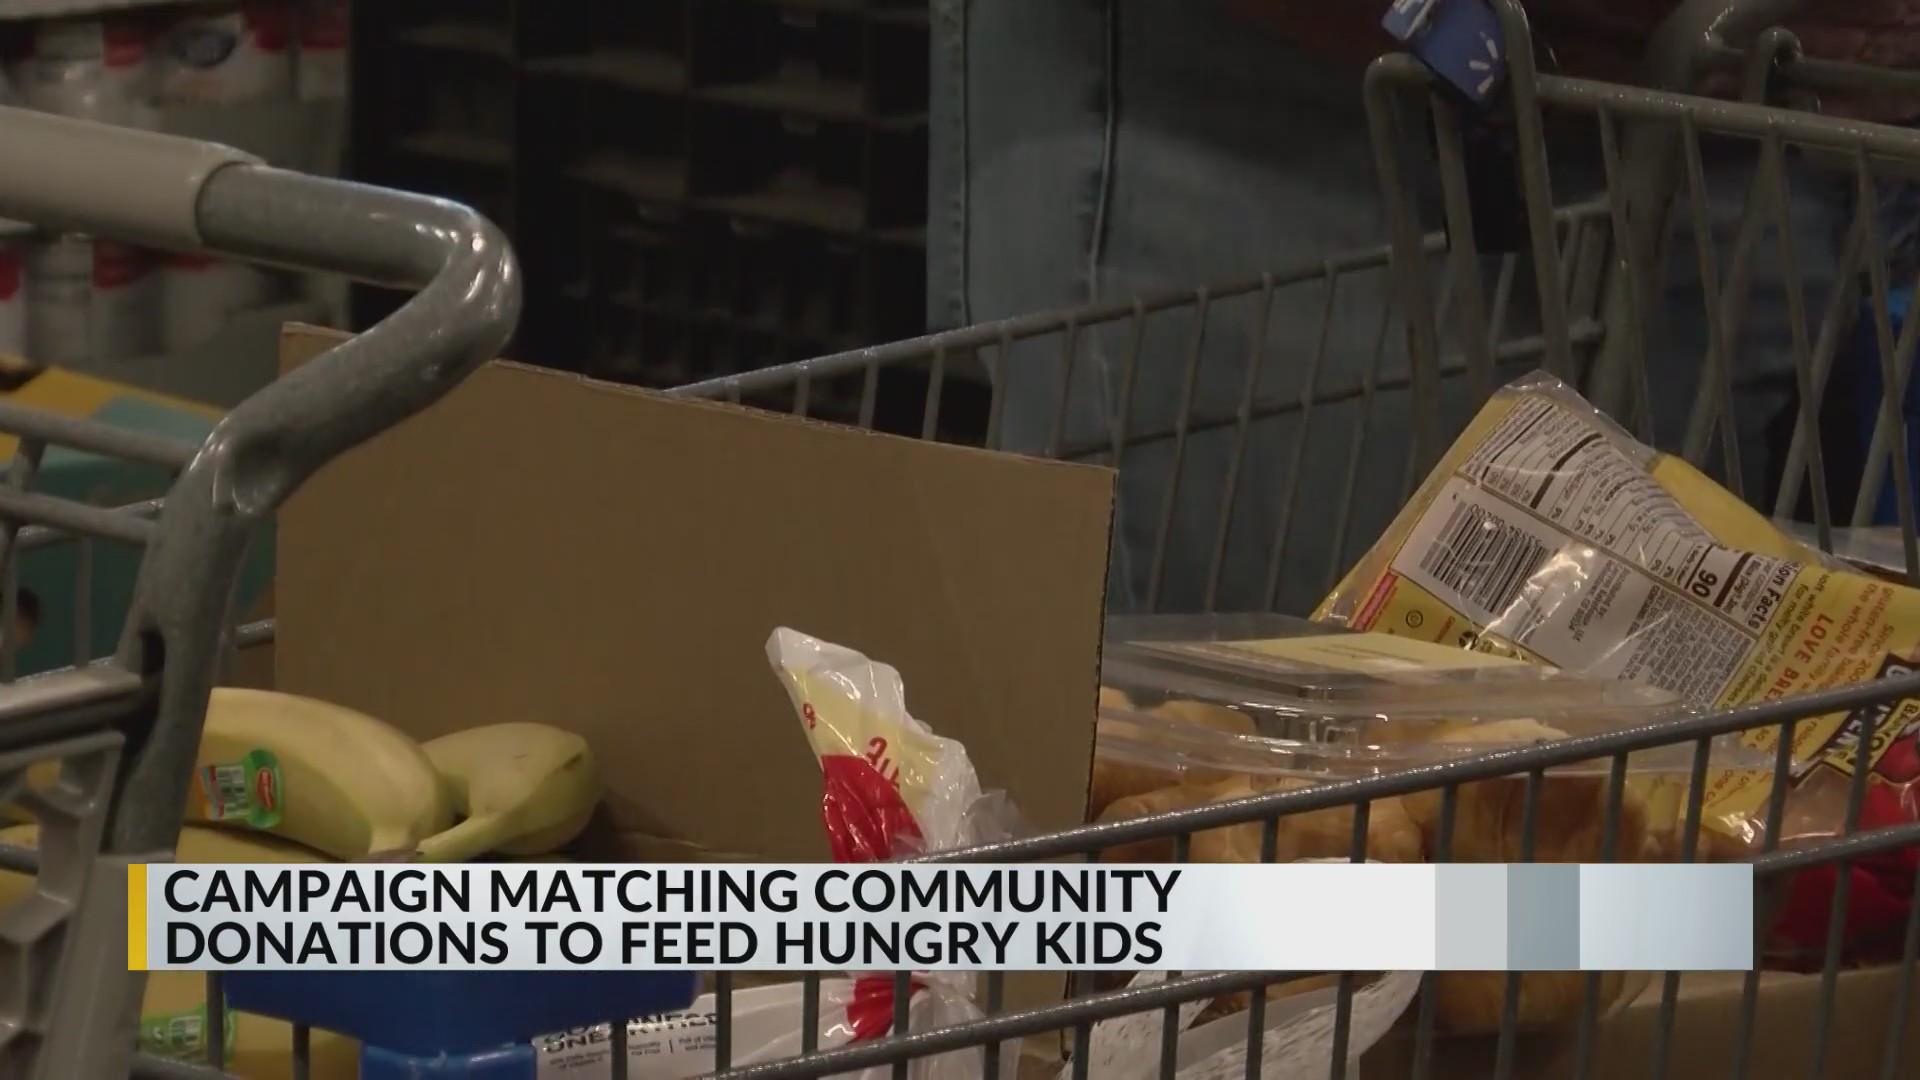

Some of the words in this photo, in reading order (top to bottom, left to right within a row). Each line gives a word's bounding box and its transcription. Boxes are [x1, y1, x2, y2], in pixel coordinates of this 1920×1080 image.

[1690, 568, 1718, 599] 90
[1746, 587, 1781, 631] Facts
[1795, 613, 1833, 663] LOVE
